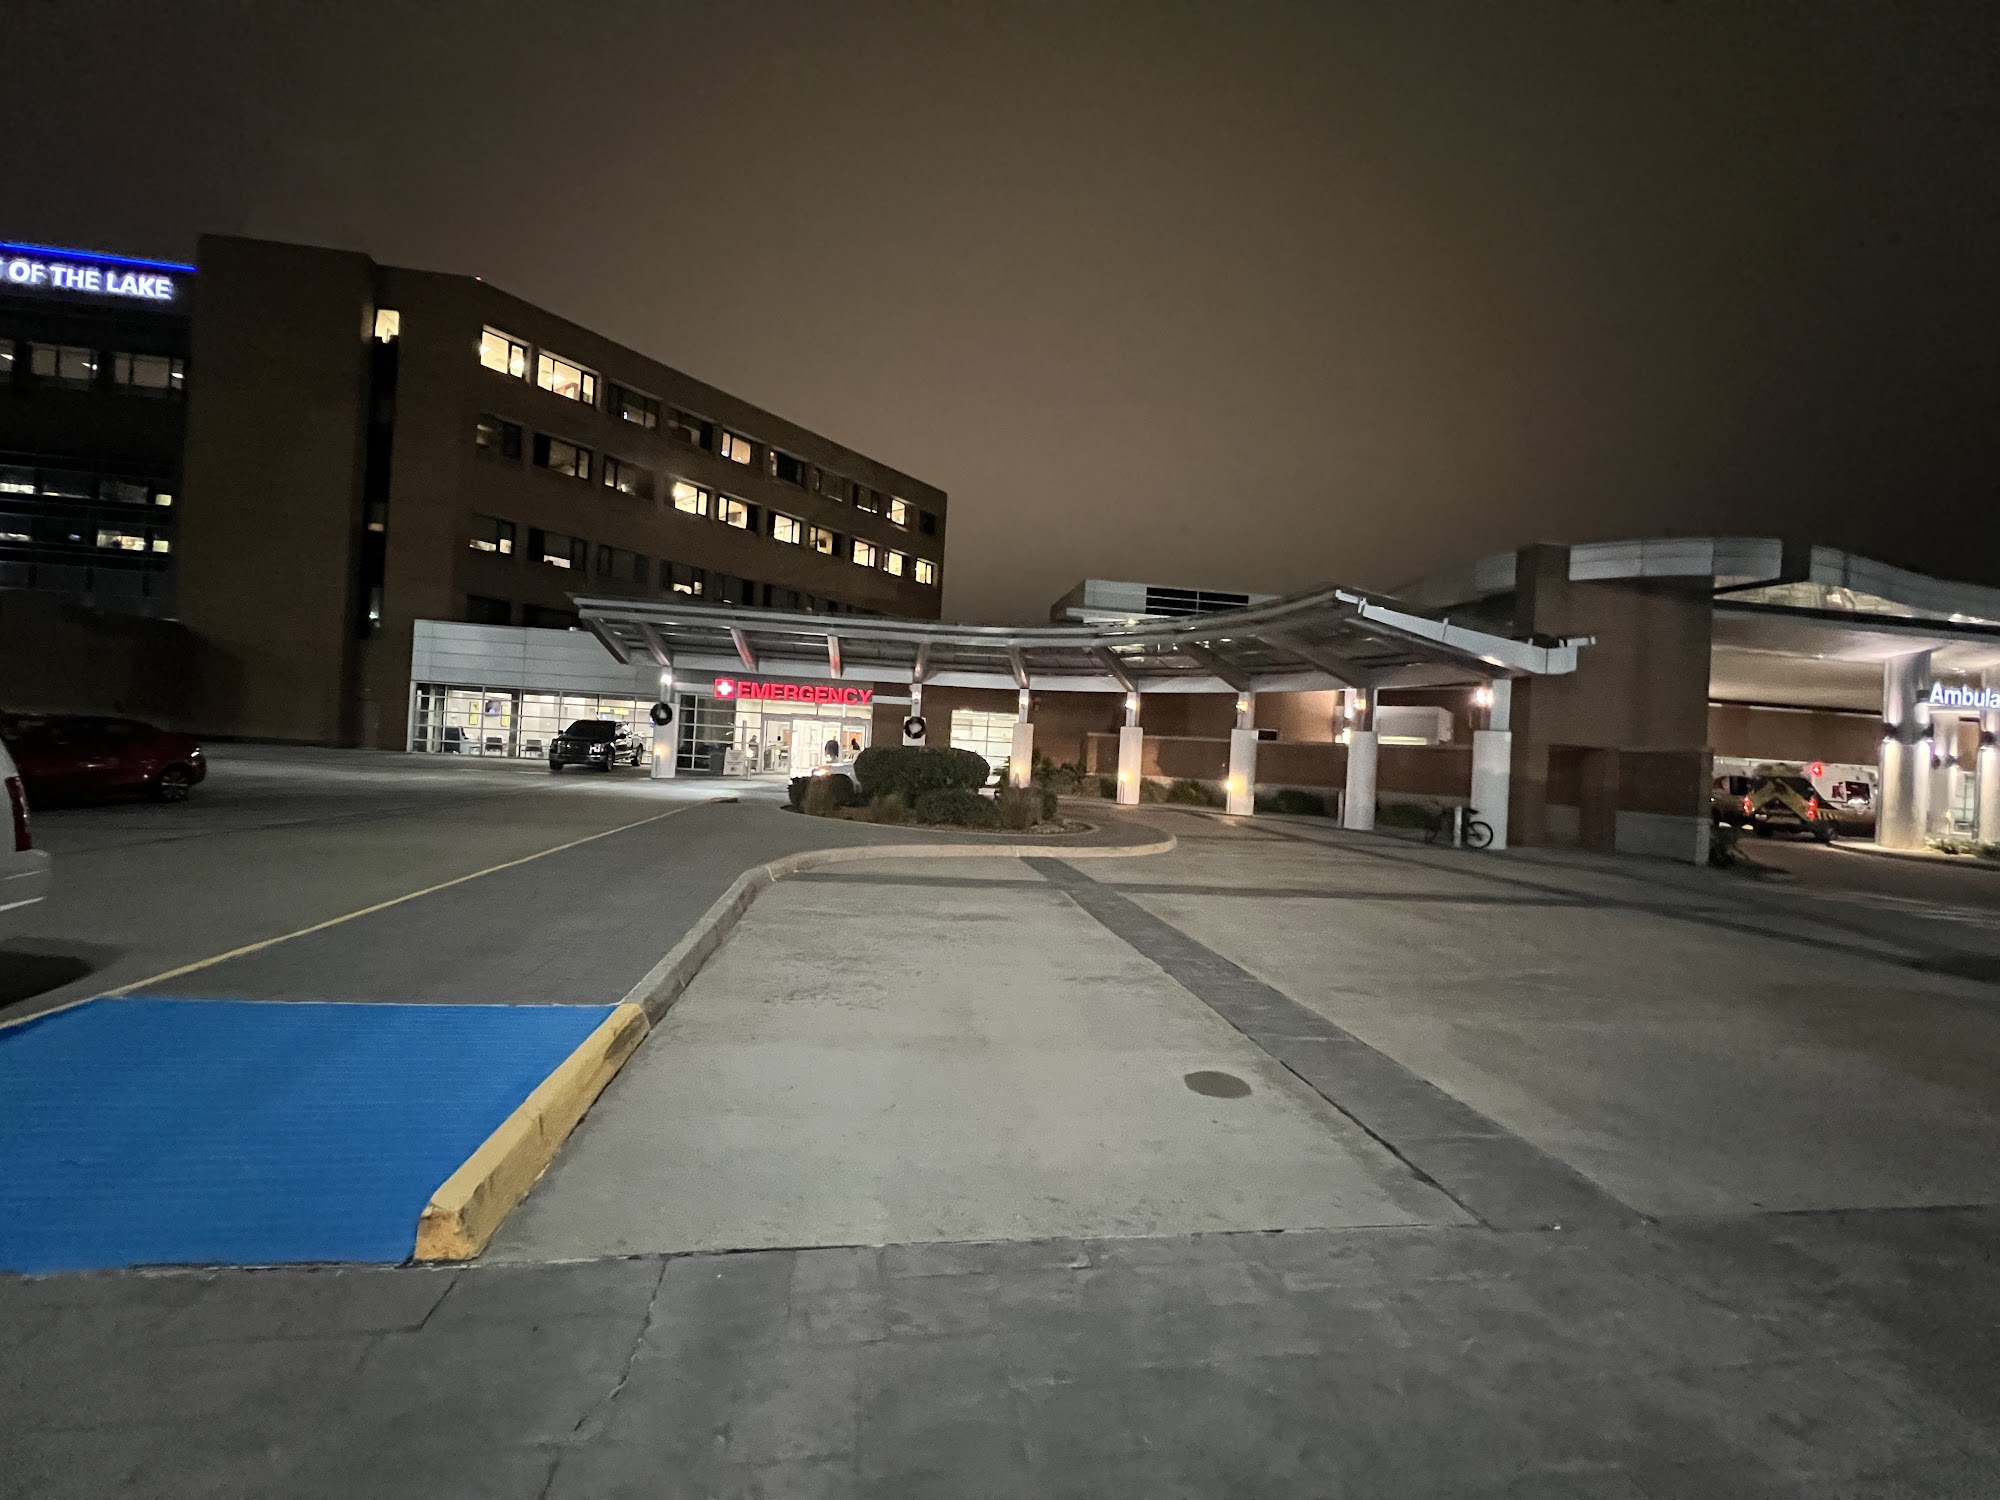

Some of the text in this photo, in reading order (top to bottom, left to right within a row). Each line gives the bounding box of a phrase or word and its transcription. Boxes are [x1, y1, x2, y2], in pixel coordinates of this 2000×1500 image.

[8, 260, 46, 283] OF
[50, 265, 100, 290] THE
[106, 272, 172, 300] LAKE
[737, 682, 873, 705] EMERGENCY
[1929, 681, 2000, 708] Ambula
